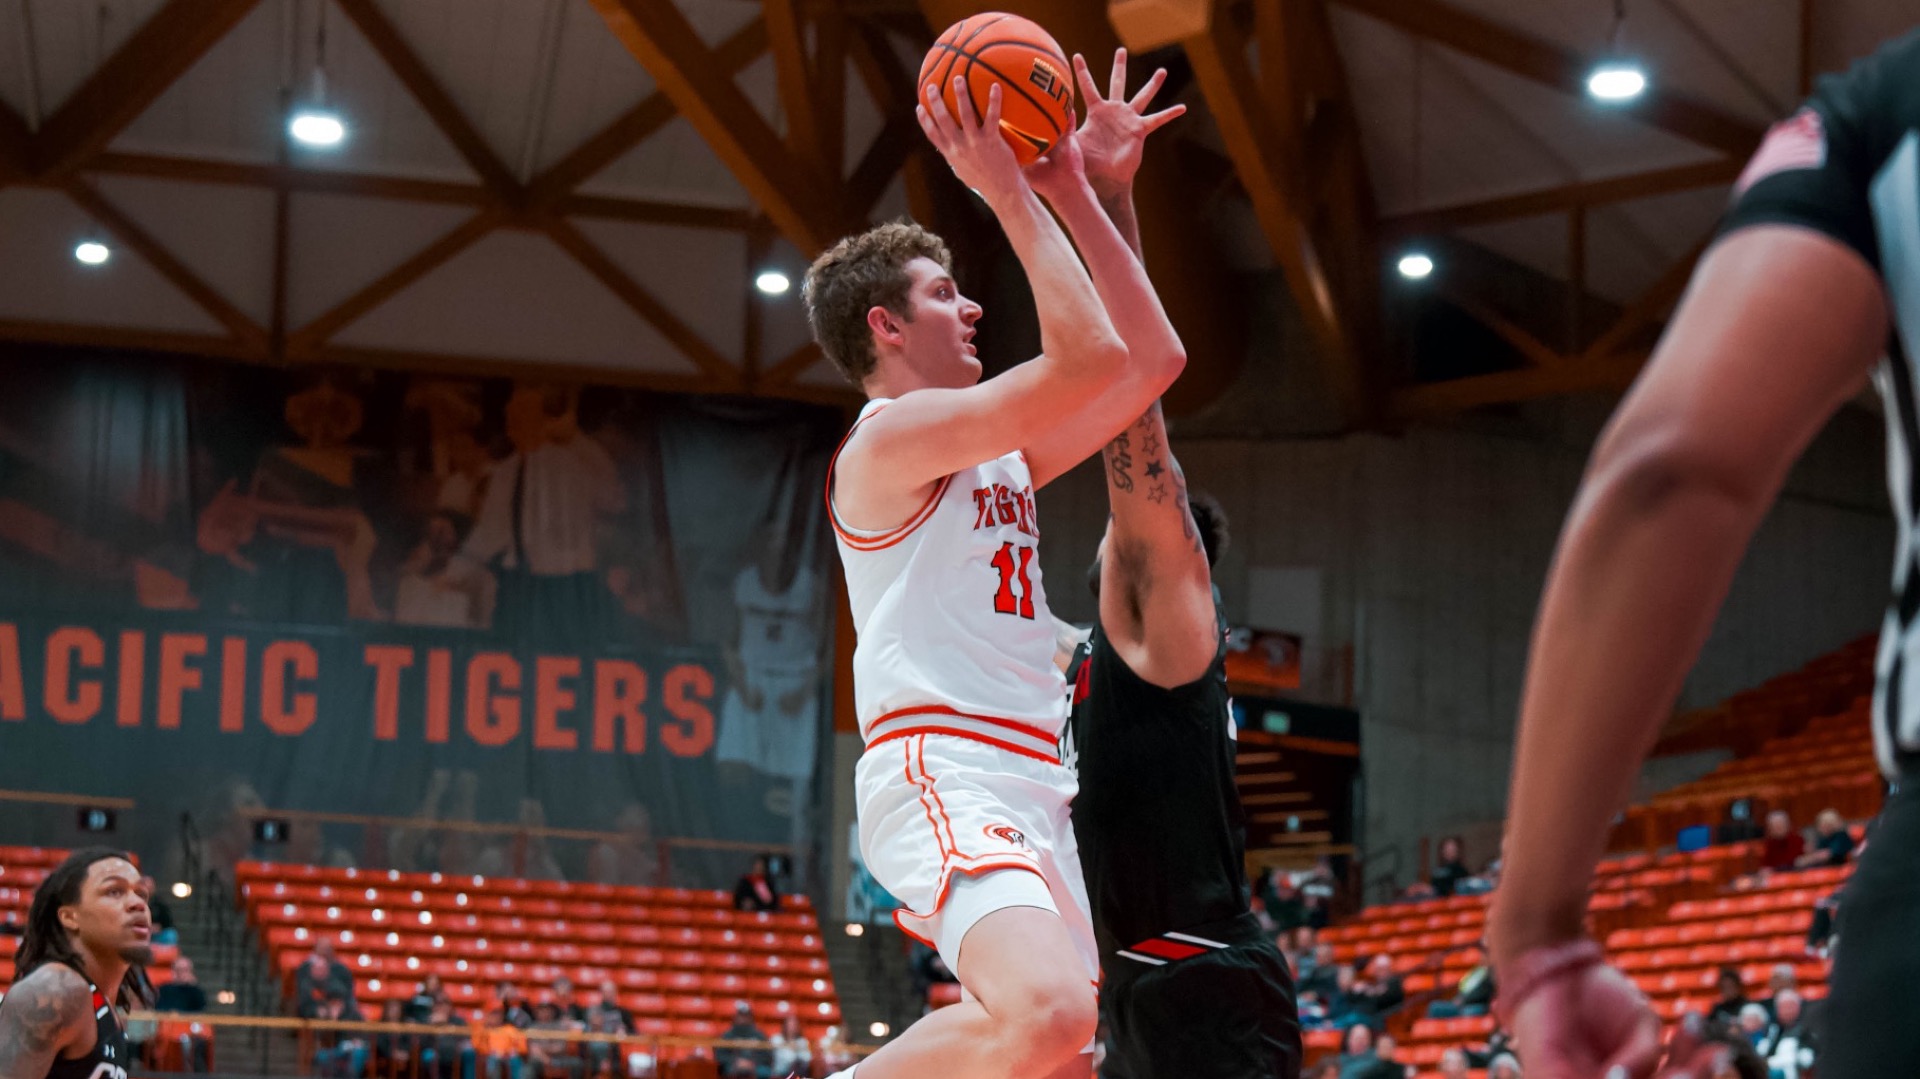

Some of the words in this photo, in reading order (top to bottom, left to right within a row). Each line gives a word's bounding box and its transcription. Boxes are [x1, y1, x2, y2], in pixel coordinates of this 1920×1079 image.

[1029, 62, 1073, 119] ELIT
[991, 541, 1035, 620] 11
[366, 648, 713, 755] TIGERS
